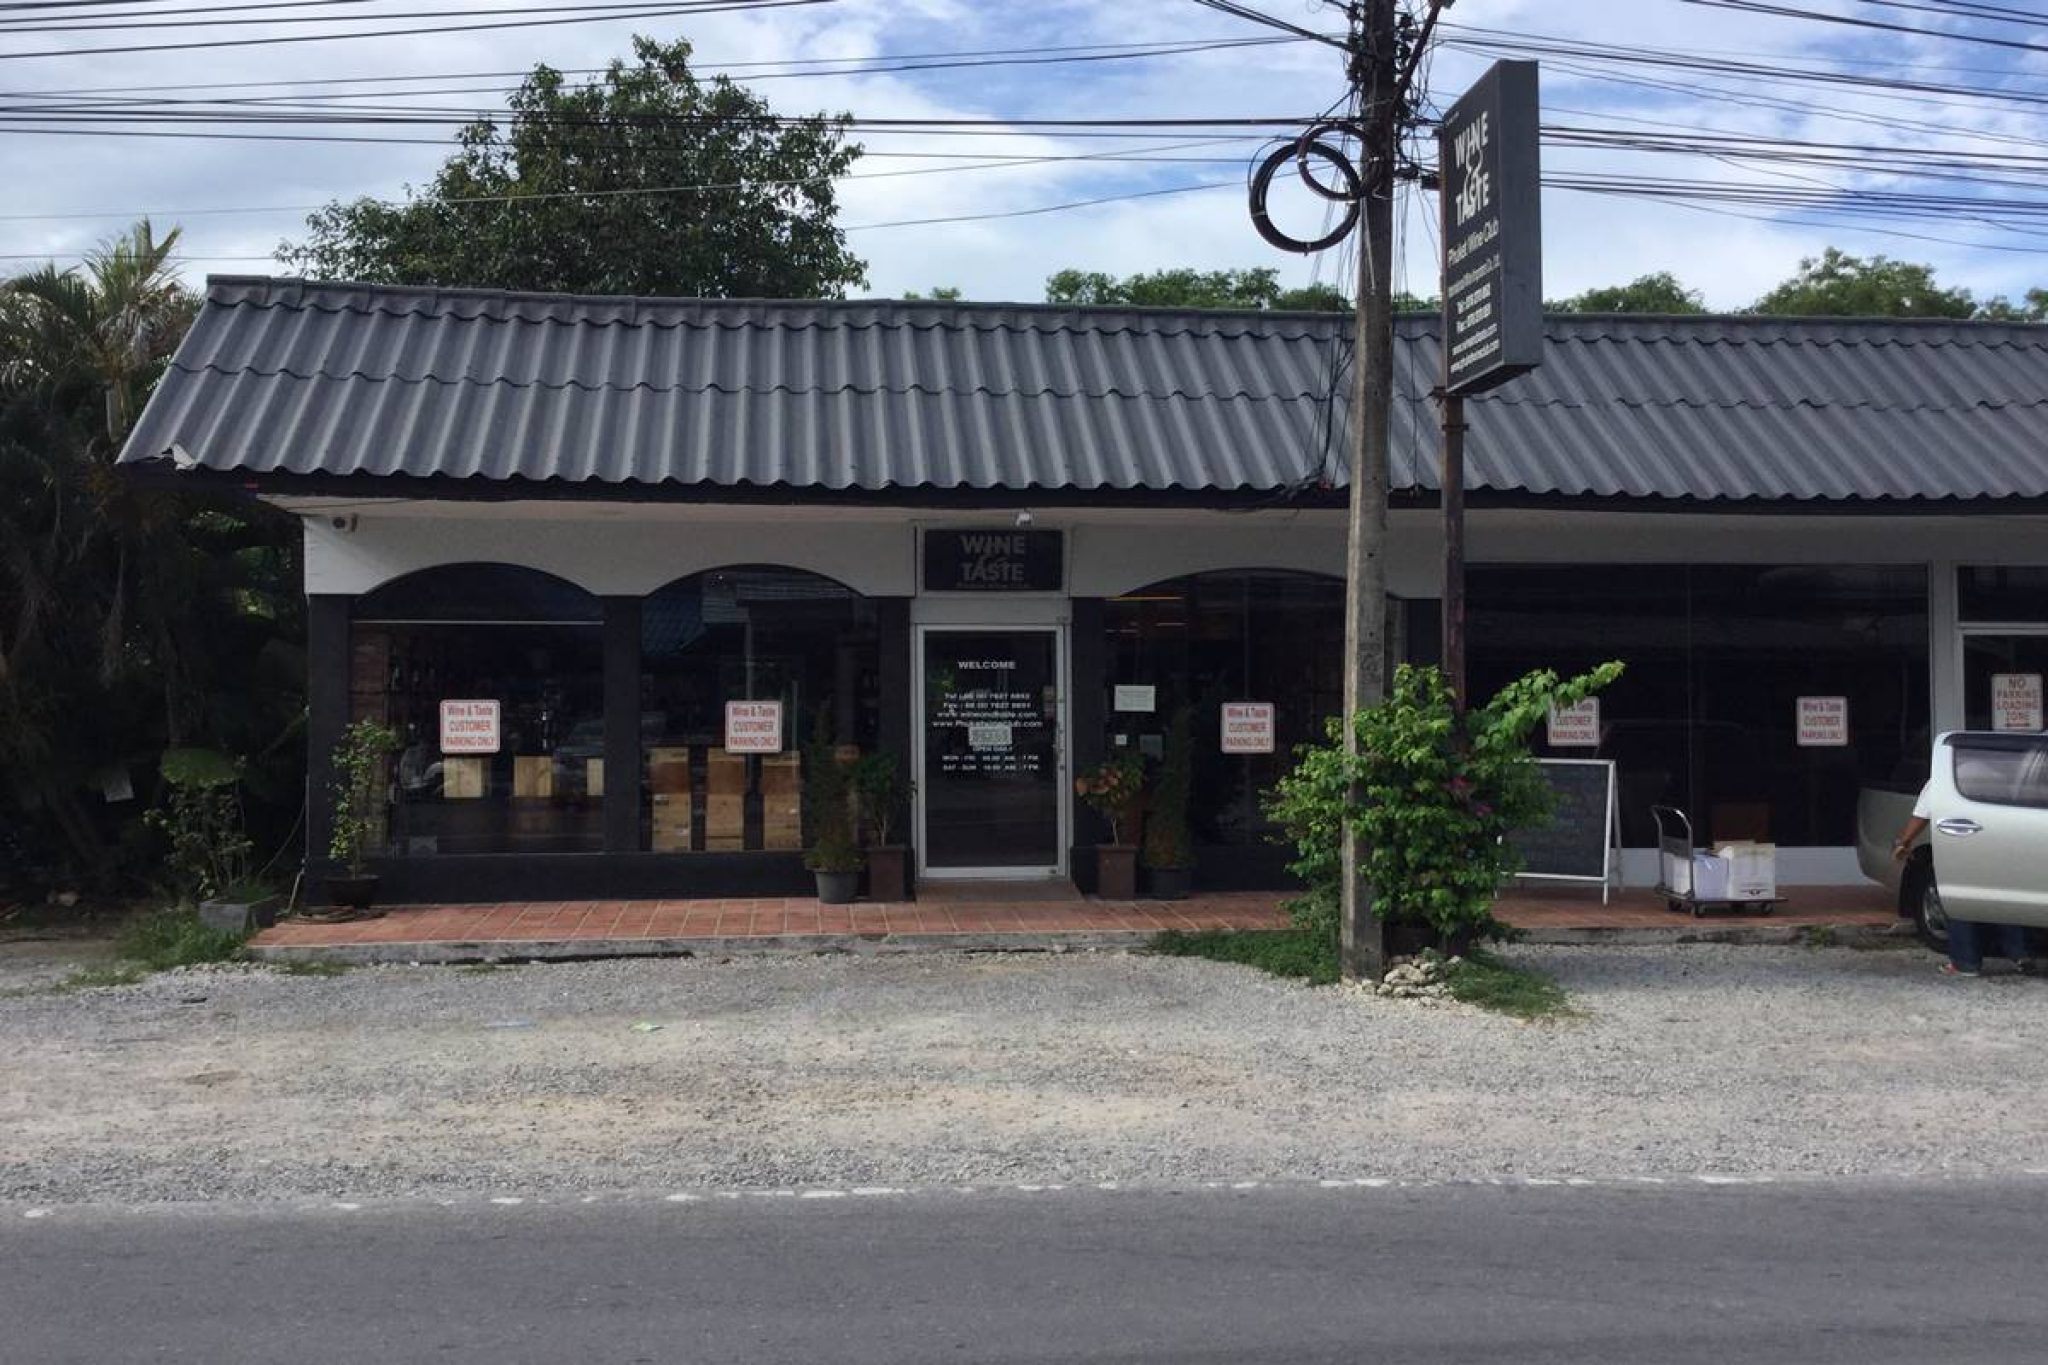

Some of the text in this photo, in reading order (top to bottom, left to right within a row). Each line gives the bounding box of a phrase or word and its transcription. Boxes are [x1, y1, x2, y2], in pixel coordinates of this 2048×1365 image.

[1454, 110, 1489, 169] WINE
[1455, 171, 1490, 227] TASTE
[960, 535, 1025, 554] WINE
[960, 563, 1025, 581] TASTE
[957, 661, 1017, 670] WELCOME
[2008, 679, 2026, 689] NO
[1995, 700, 2040, 710] LOADING
[448, 720, 492, 732] CUSTOMER
[733, 720, 774, 733] CUSTOMER
